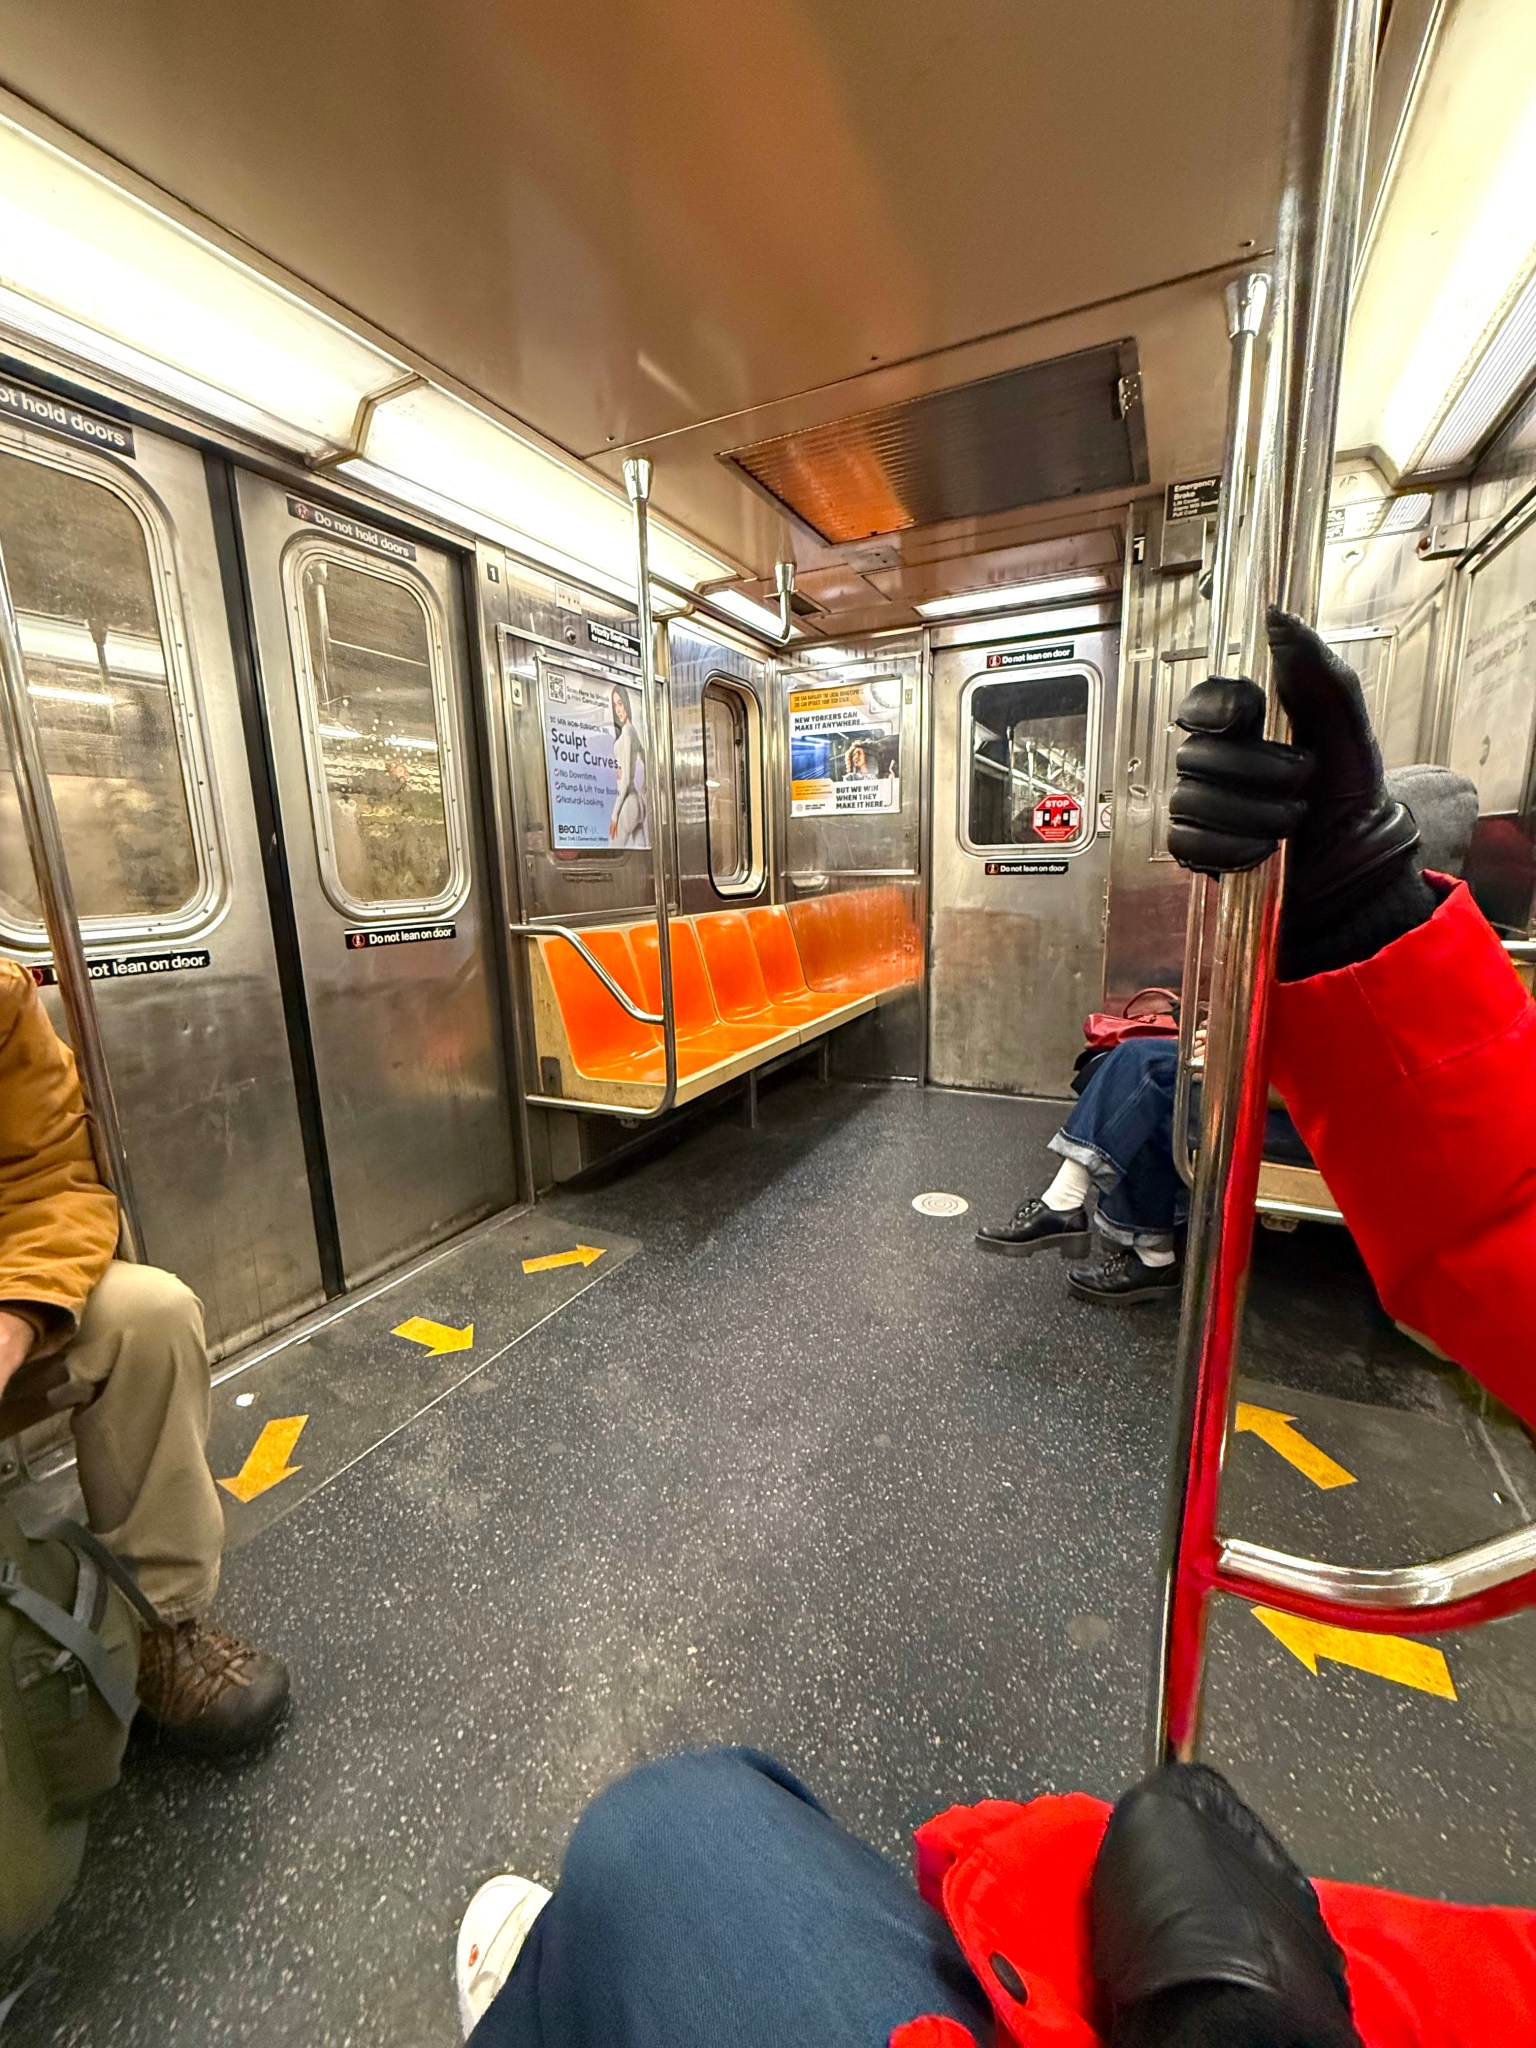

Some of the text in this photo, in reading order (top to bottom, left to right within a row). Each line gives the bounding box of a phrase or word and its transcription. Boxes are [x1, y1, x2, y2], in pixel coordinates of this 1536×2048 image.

[0, 388, 125, 446] ot hold doors
[1174, 479, 1216, 492] Emergency
[1173, 491, 1196, 500] Brake
[315, 510, 409, 556] Do not hold doors
[1134, 540, 1145, 560] 1
[490, 567, 496, 580] 1
[1002, 656, 1012, 664] Do
[1026, 653, 1042, 661] lean
[1053, 649, 1071, 657] door
[794, 711, 857, 724] NEW YORKERS CAN
[794, 723, 813, 732] MAKE
[551, 727, 588, 750] Sculpt
[552, 745, 622, 769] Your Curves.
[561, 782, 578, 792] Plump
[584, 785, 593, 793] Lift
[594, 786, 605, 794] Your
[836, 786, 850, 794] BUT
[836, 794, 857, 802] WHEN
[836, 801, 856, 809] MAKE
[369, 928, 452, 944] Do not lean on door
[113, 961, 147, 975] lean
[150, 959, 169, 971] on
[173, 955, 205, 968] door
